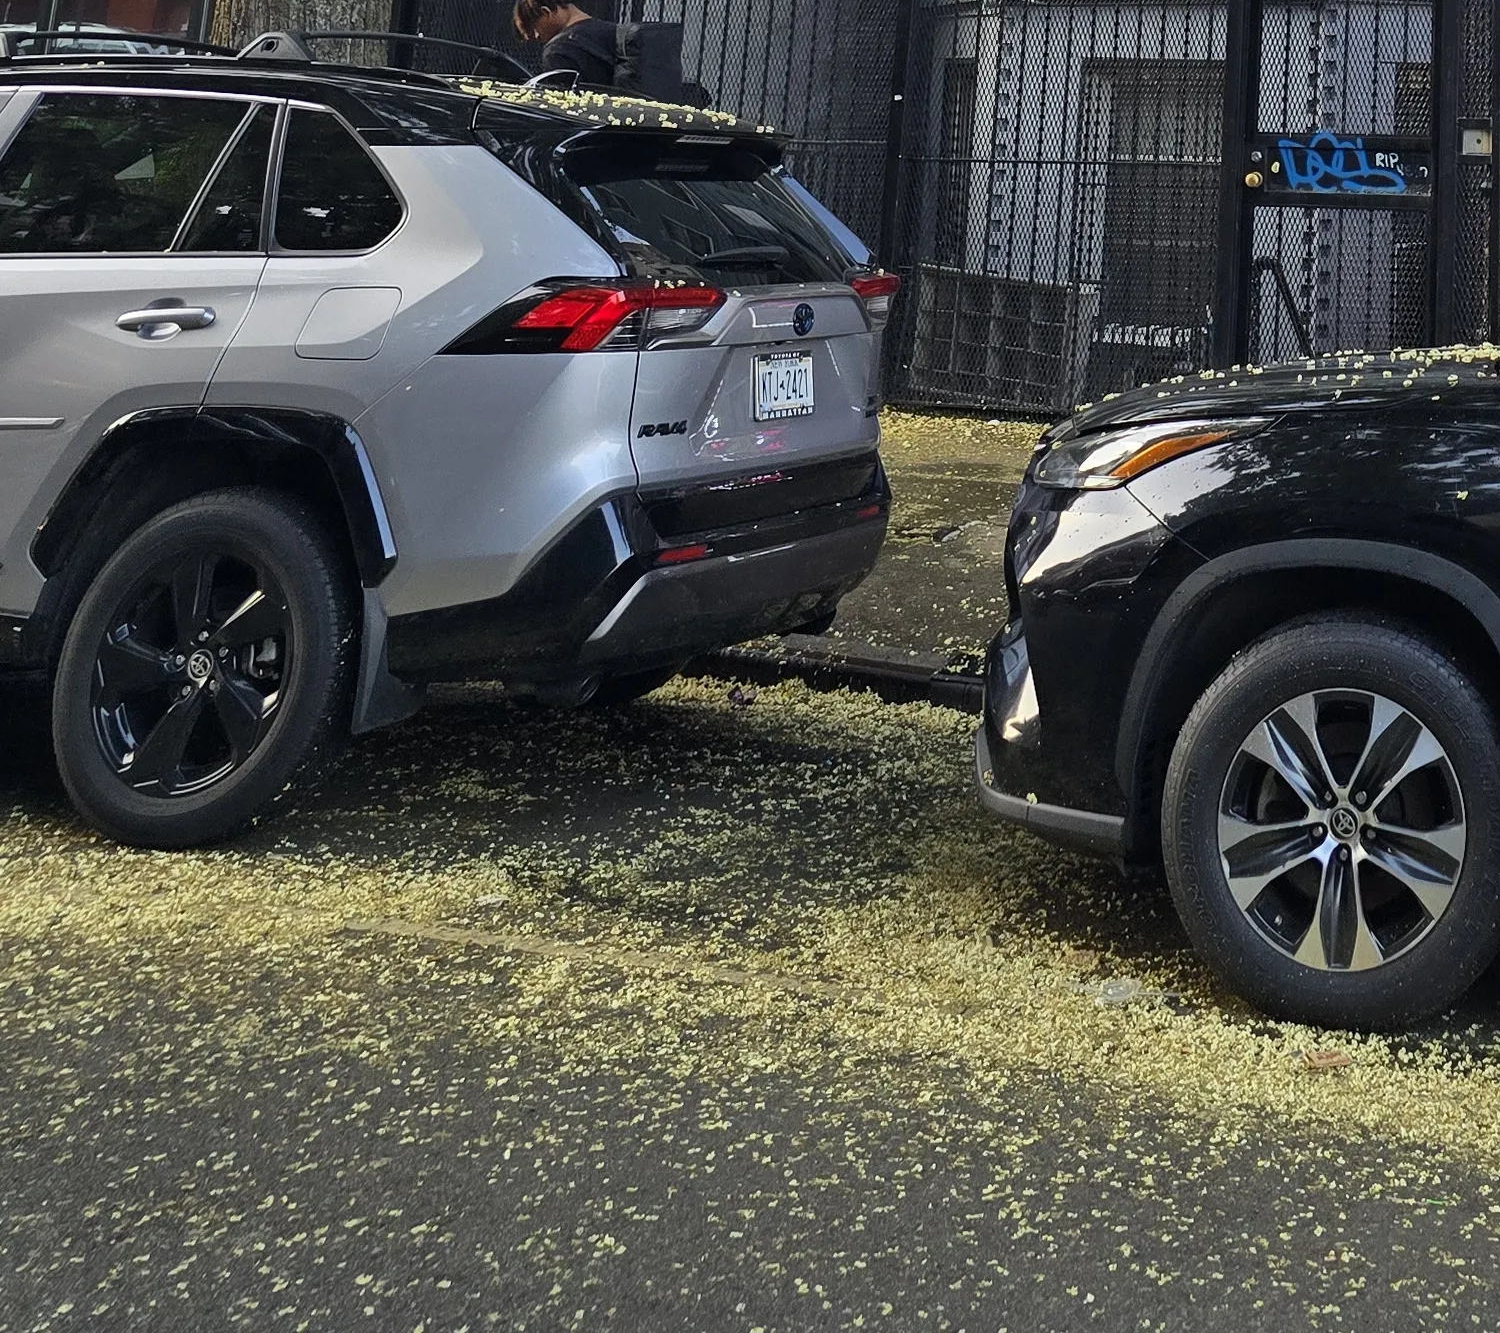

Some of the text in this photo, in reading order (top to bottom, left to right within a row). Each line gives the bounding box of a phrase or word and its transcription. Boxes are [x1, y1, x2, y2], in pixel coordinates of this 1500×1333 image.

[1375, 153, 1399, 169] RIP
[762, 406, 813, 420] MANHATTAN
[636, 419, 688, 439] RAV4
